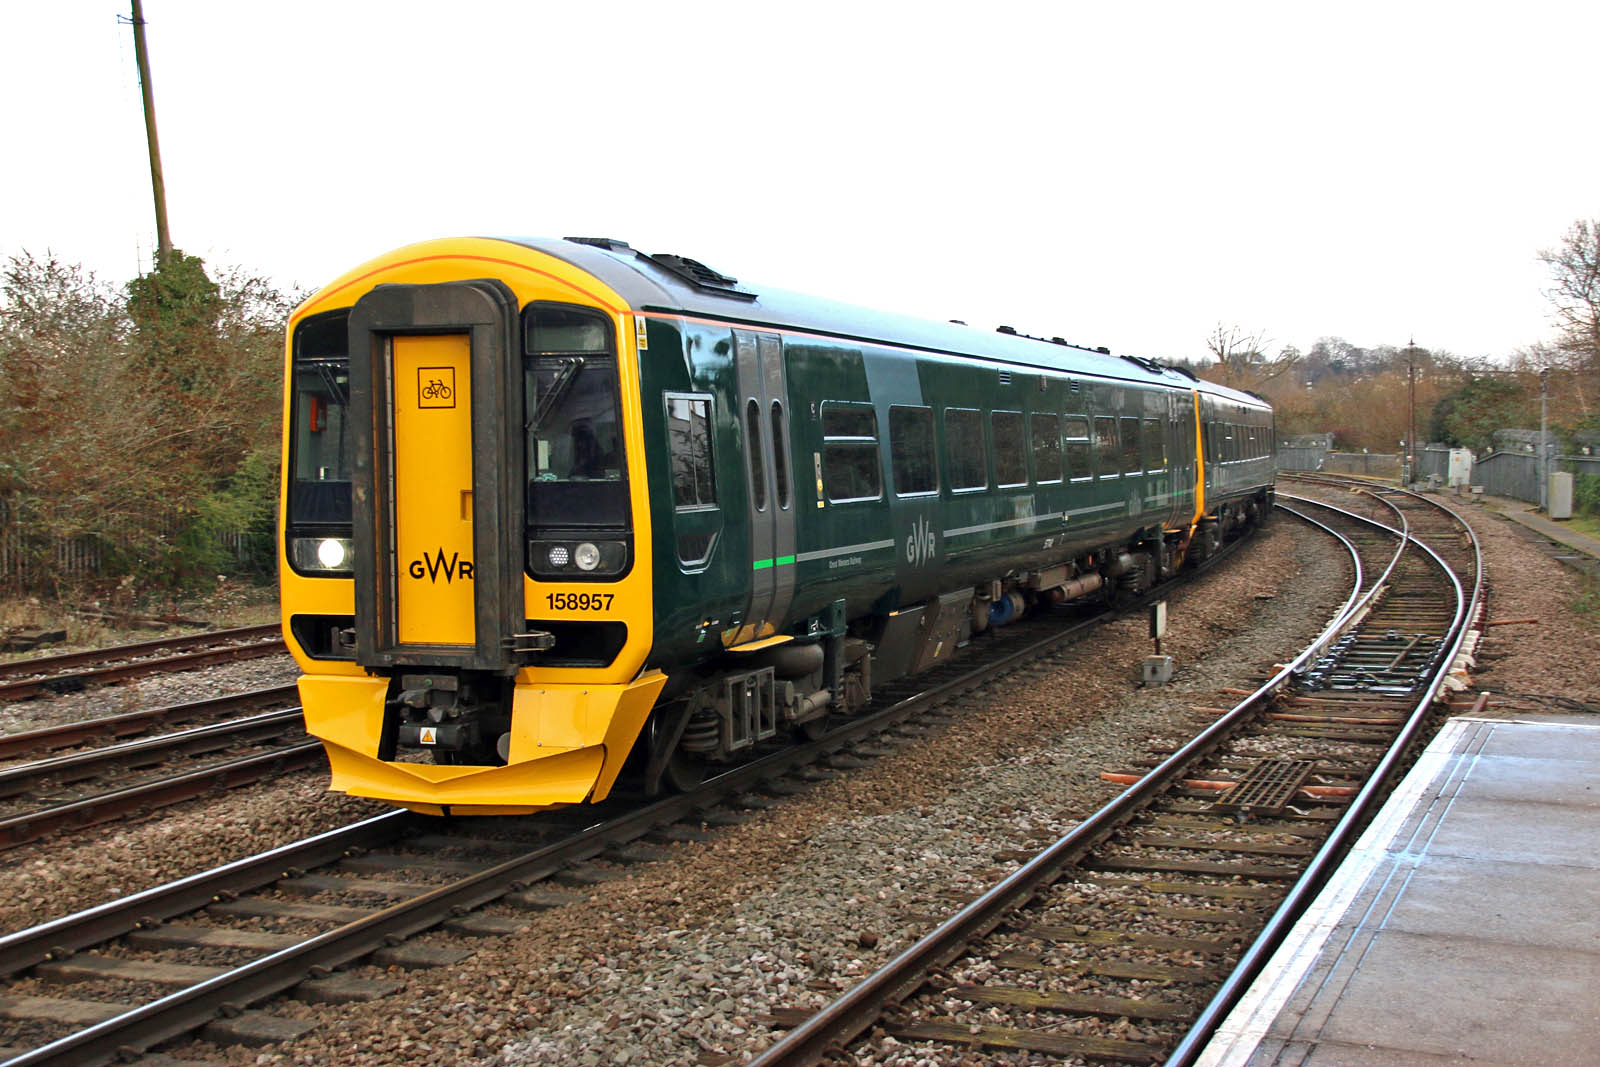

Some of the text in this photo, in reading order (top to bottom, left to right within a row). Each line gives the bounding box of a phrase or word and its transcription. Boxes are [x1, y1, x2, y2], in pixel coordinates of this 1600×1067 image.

[906, 514, 936, 568] GWR
[409, 547, 474, 584] GWR
[546, 593, 614, 611] 158957
